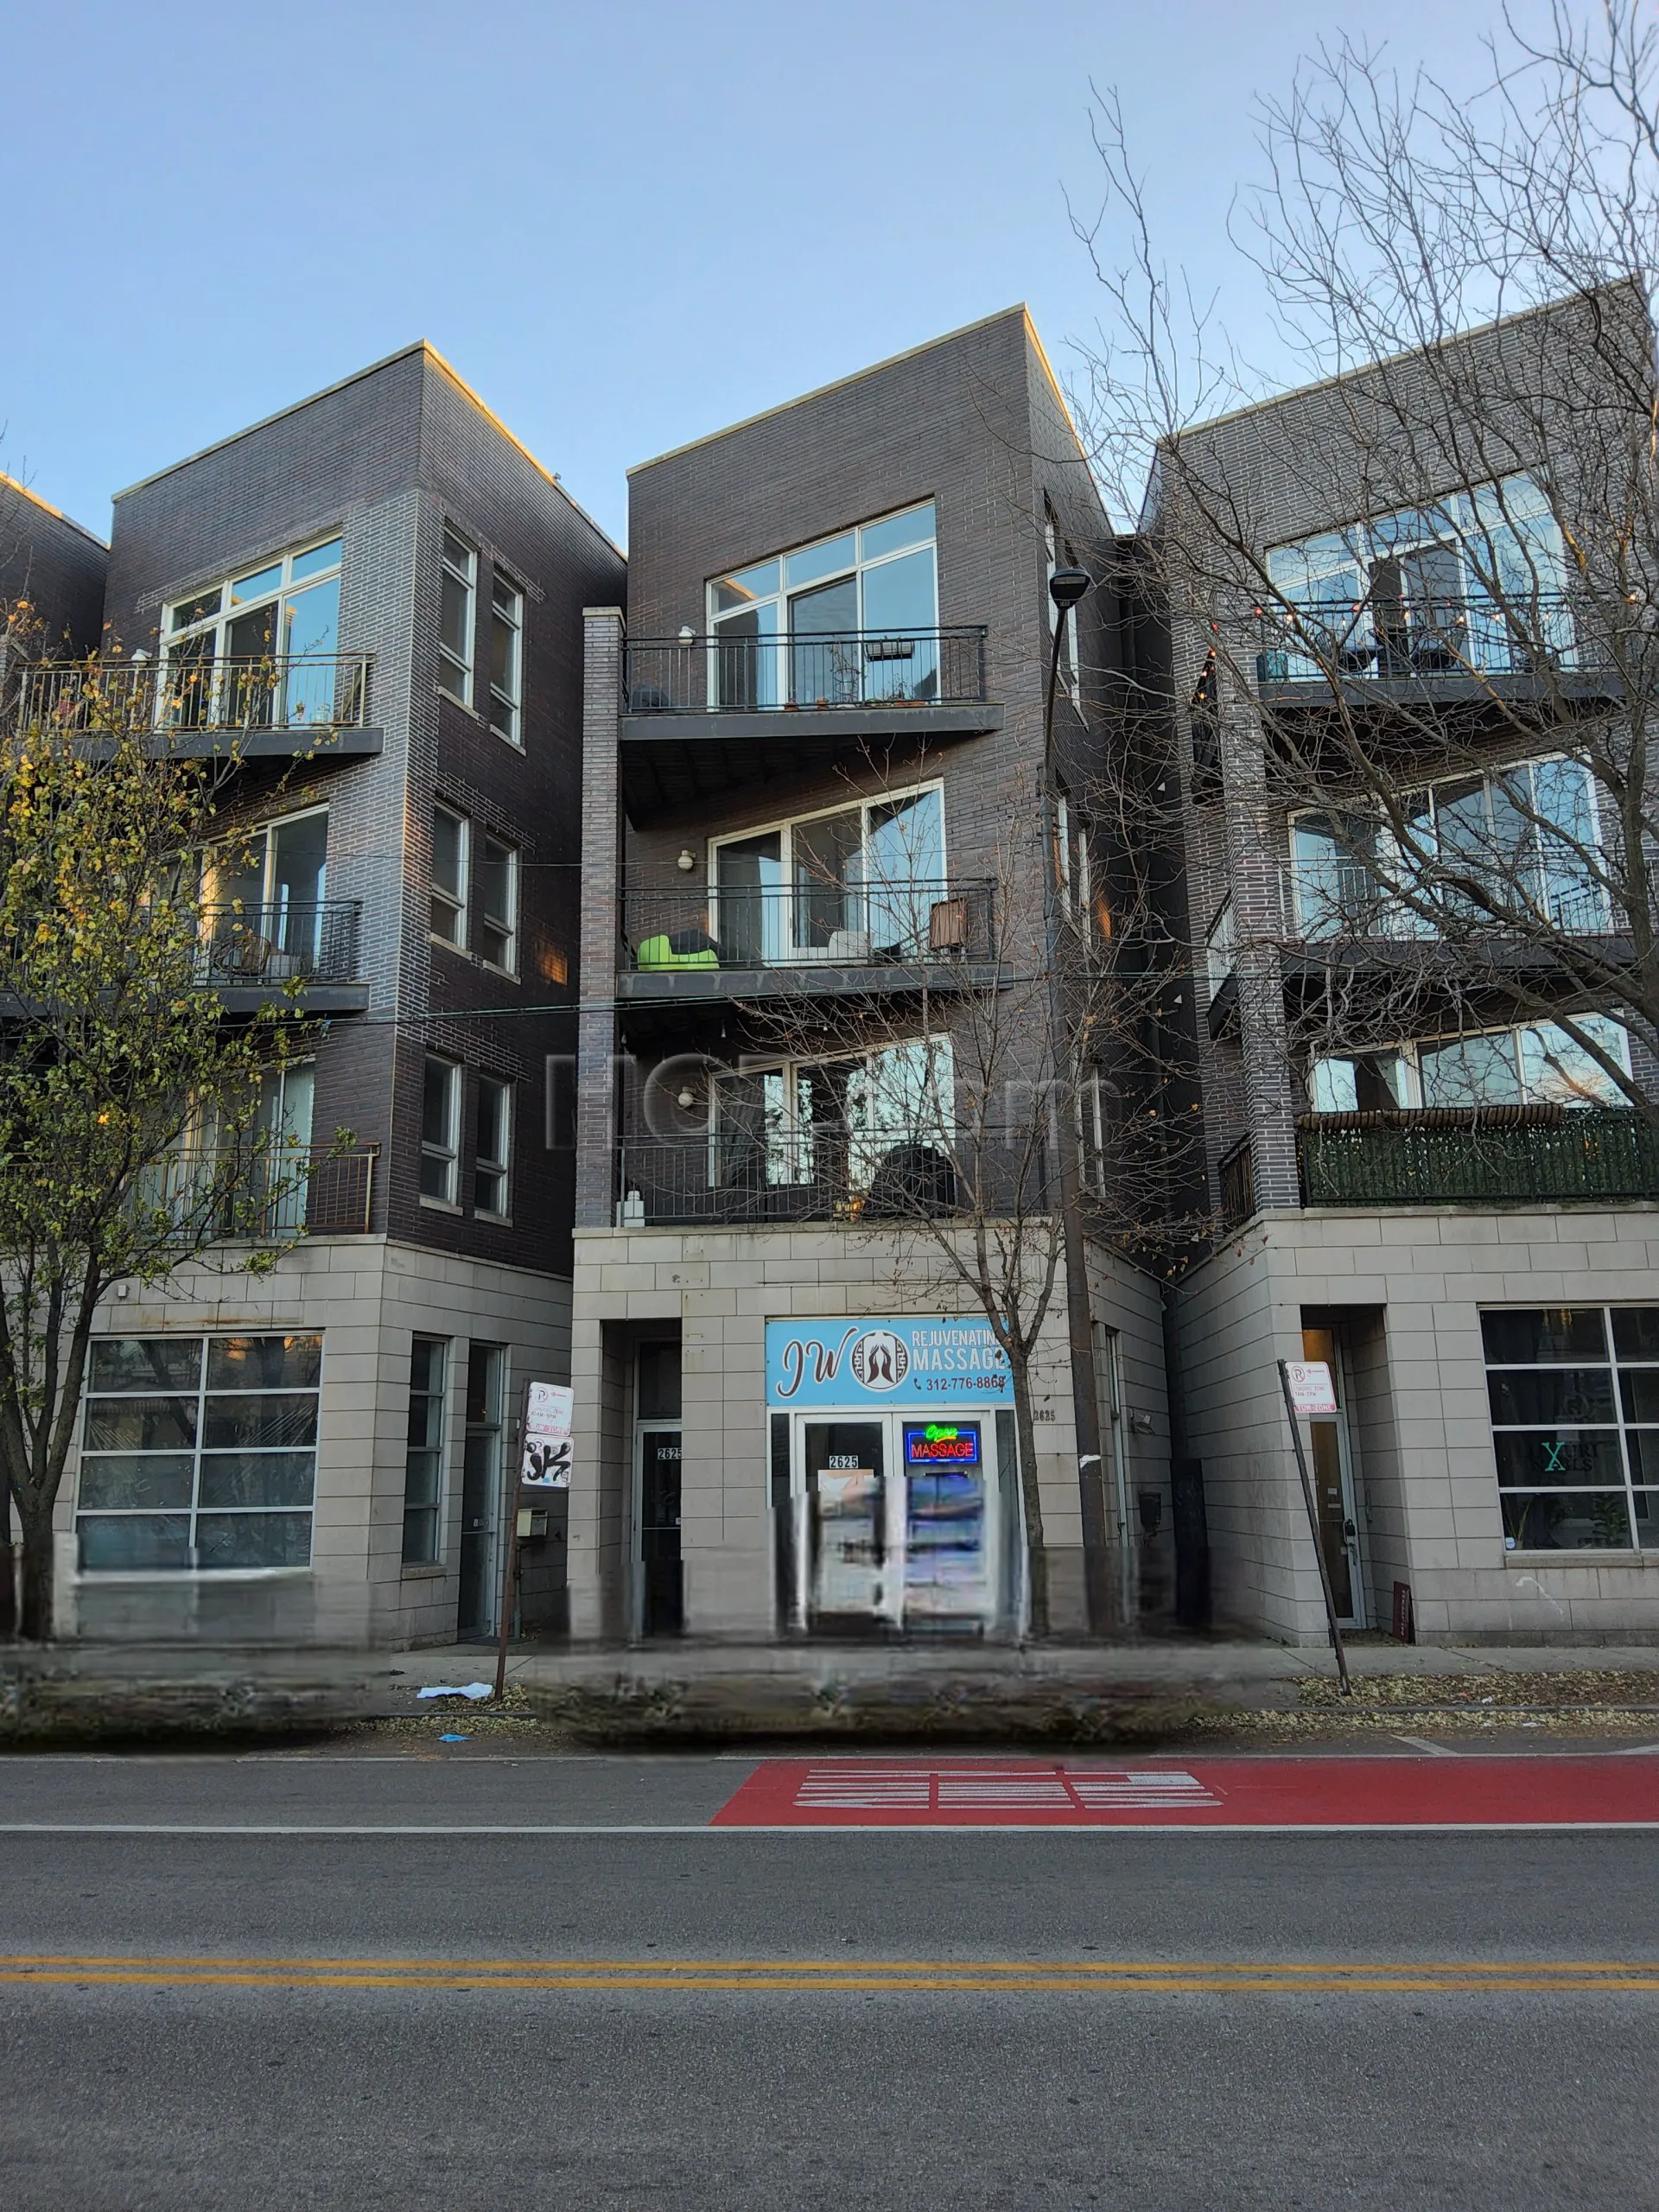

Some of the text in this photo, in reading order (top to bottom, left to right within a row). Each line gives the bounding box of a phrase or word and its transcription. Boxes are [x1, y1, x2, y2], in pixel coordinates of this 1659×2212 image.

[912, 1347, 1006, 1371] MASSAGE
[1033, 1409, 1056, 1422] 2625
[925, 1424, 958, 1441] Open
[658, 1448, 683, 1459] 2625
[911, 1442, 974, 1458] MASSAGE
[830, 1456, 858, 1468] 2625
